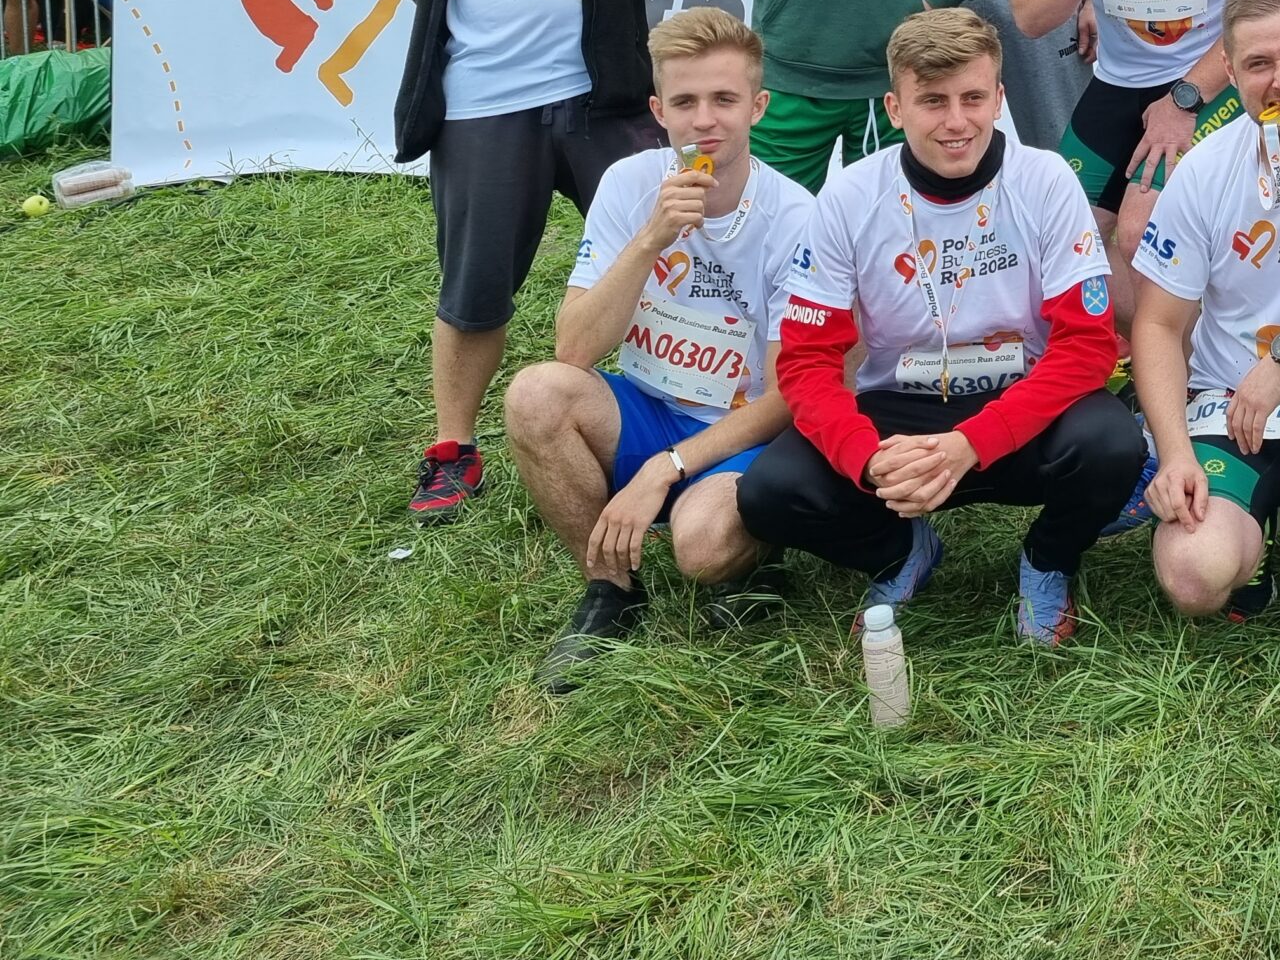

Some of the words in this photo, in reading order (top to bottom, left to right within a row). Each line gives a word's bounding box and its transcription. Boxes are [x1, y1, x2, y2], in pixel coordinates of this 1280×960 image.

[942, 231, 997, 254] Polnd
[792, 243, 812, 270] LS
[941, 243, 1008, 270] Buness
[979, 253, 1019, 276] 2022
[688, 285, 722, 298] Run
[923, 282, 940, 318] Poland
[651, 306, 679, 322] Poland
[678, 315, 712, 331] Business
[712, 325, 727, 335] Run
[727, 329, 748, 339] 2022
[624, 324, 744, 379] M0630/3
[914, 359, 941, 367] Poland
[943, 357, 976, 365] usiness
[977, 355, 993, 363] Run
[994, 354, 1016, 362] 2022
